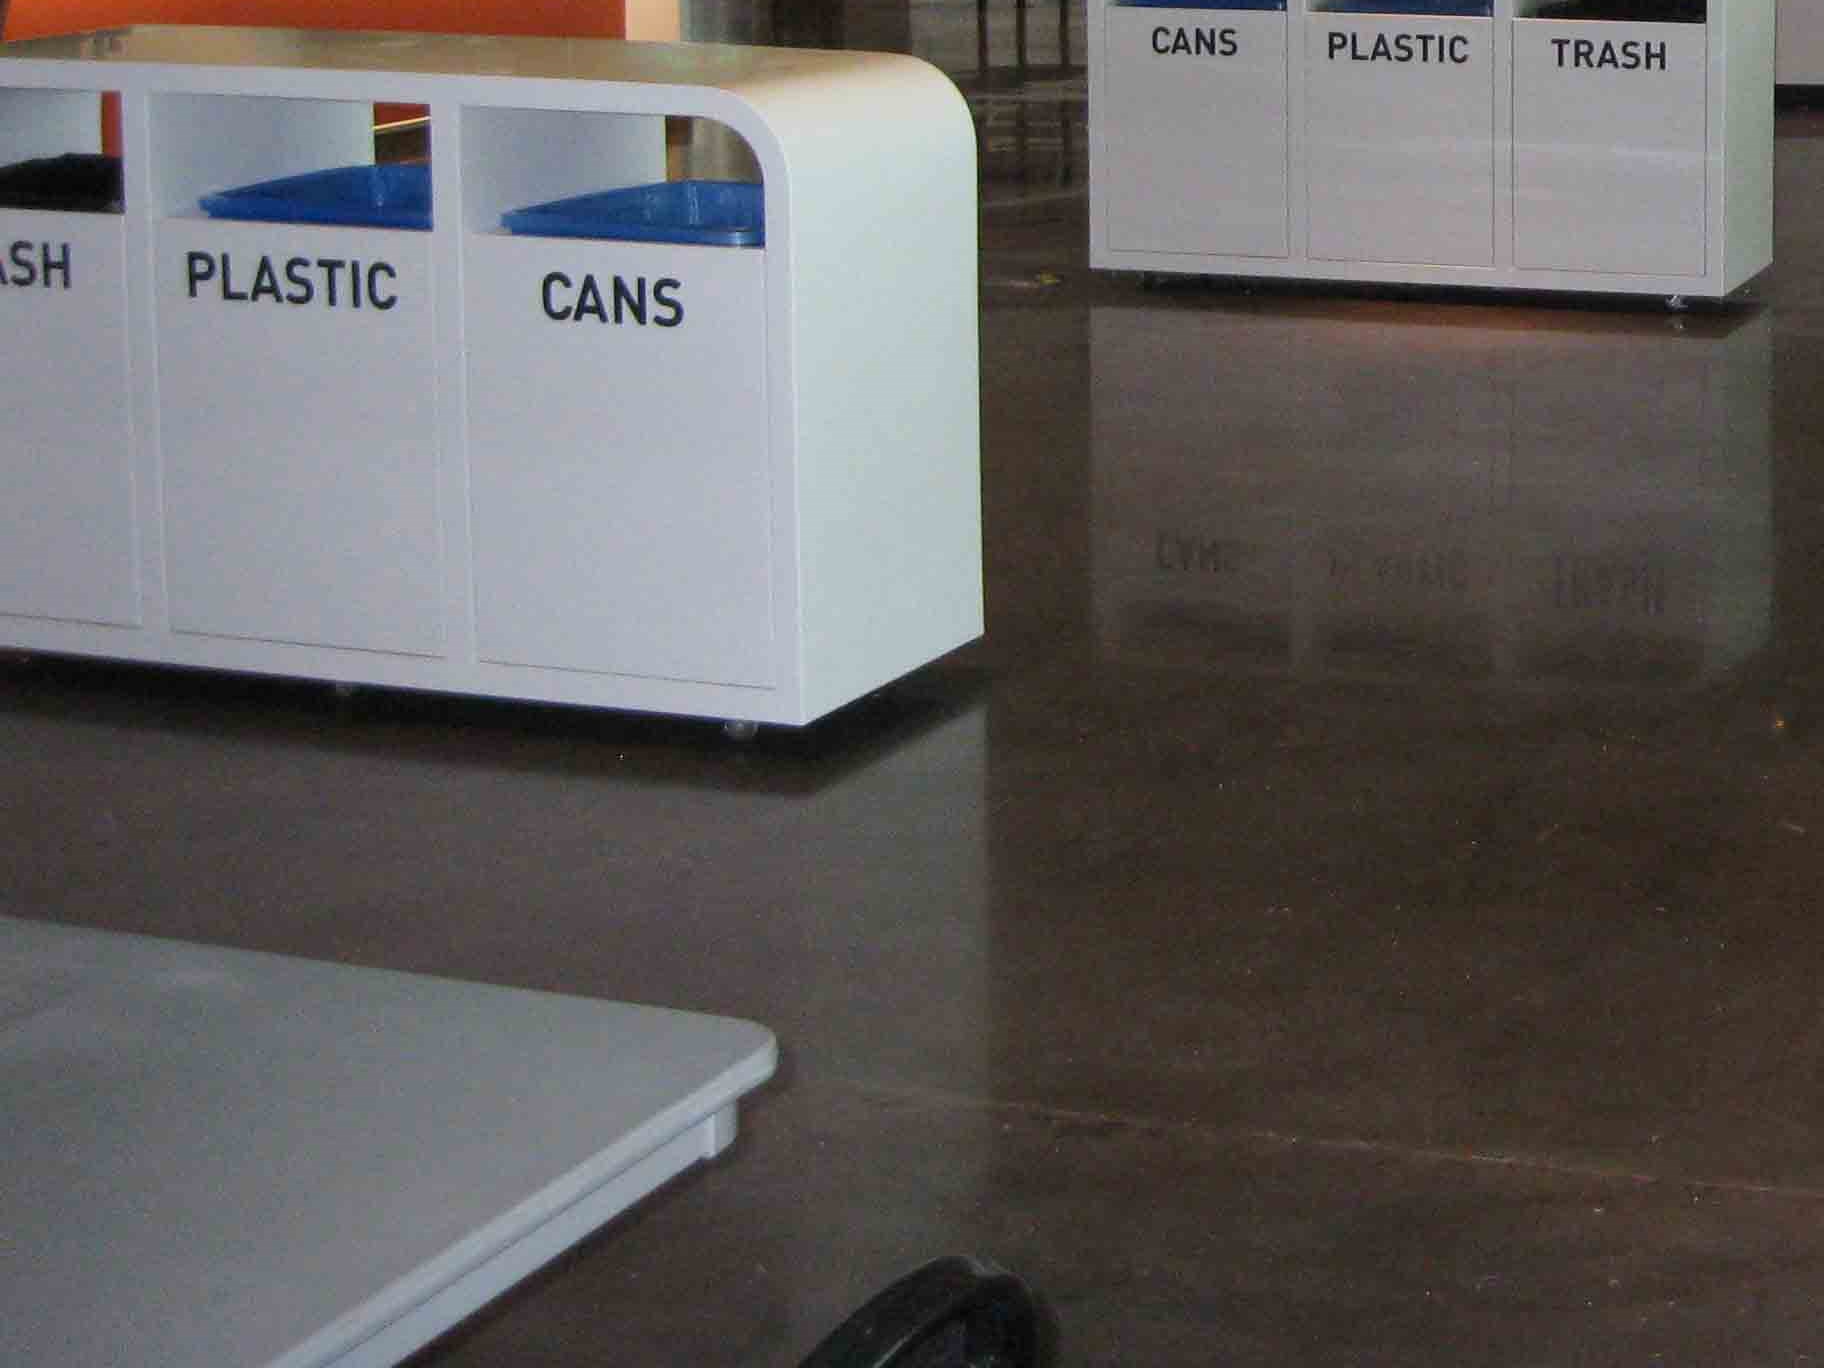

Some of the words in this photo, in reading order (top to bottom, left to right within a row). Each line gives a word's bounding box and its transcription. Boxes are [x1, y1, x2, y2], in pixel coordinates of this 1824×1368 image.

[1152, 26, 1238, 57] CANS
[1328, 31, 1468, 64] PLASTIC
[1551, 38, 1666, 71] TRASH
[187, 251, 396, 310] PLASTIC
[542, 271, 684, 328] CANS
